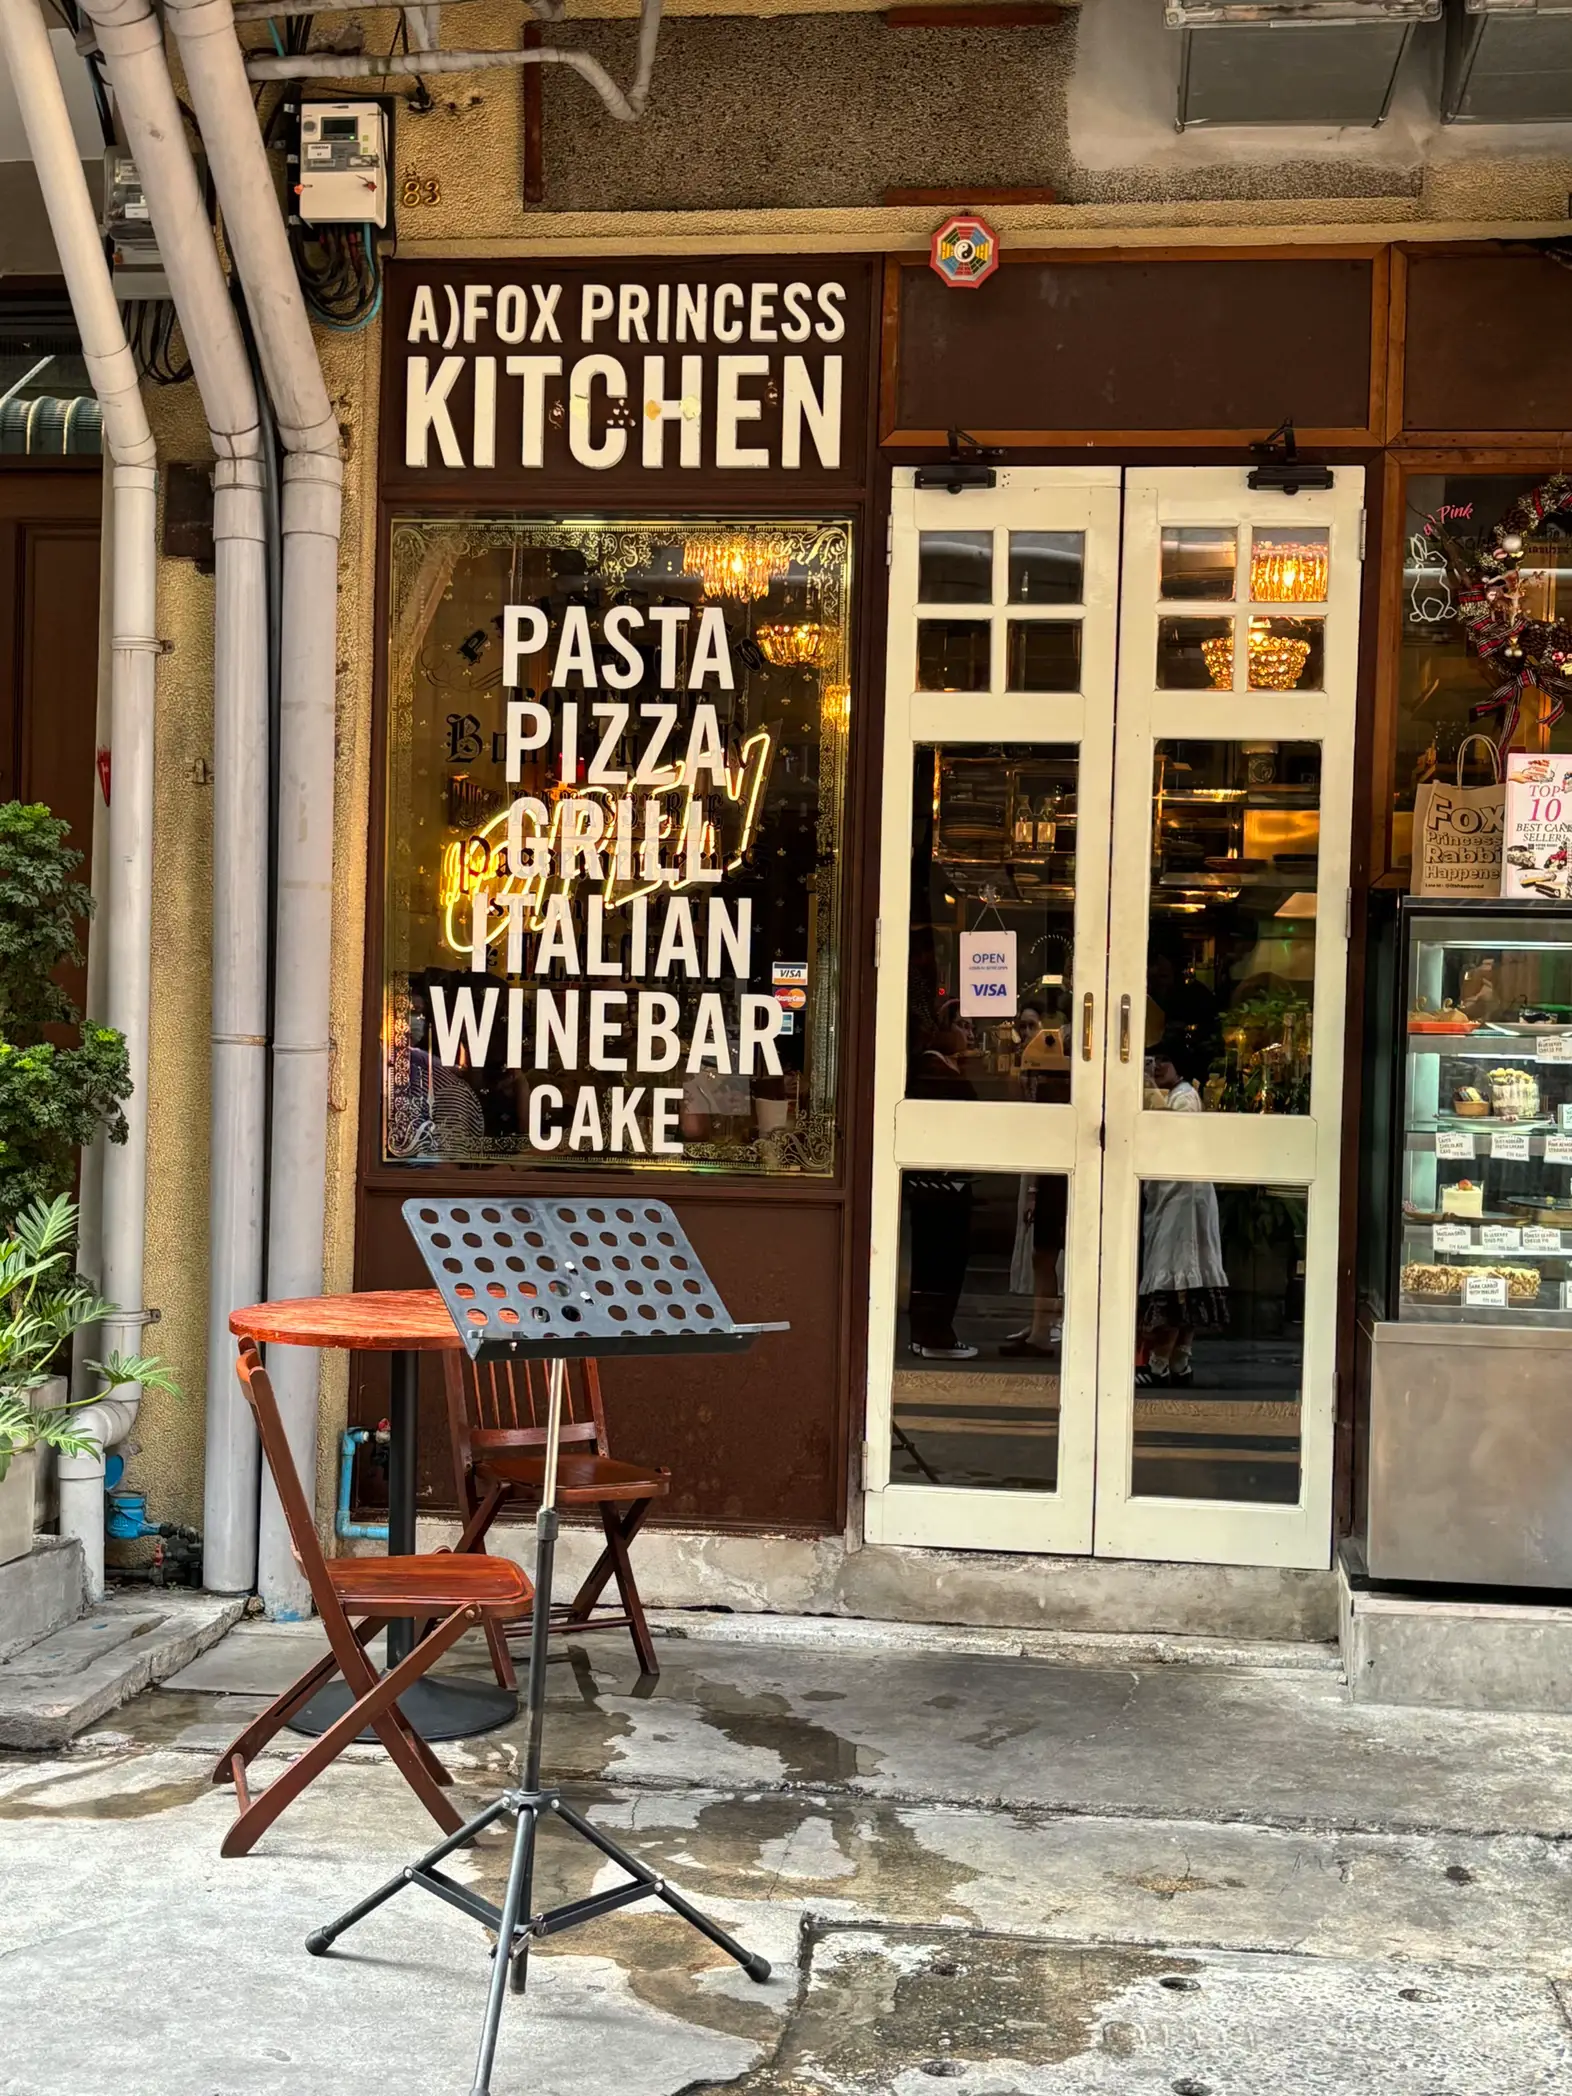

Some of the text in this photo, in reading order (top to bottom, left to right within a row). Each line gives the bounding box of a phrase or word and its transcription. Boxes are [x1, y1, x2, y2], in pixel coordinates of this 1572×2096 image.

[403, 180, 441, 206] 83
[406, 282, 847, 350] A)FOX PRINCESS
[404, 353, 843, 470] KITCHEN
[1436, 502, 1474, 525] Pink
[502, 604, 735, 690] PASTA
[505, 702, 728, 787] PIZZA
[1529, 785, 1561, 798] TOP
[1528, 798, 1562, 822] 10
[506, 796, 724, 883] GRILL
[1426, 829, 1503, 847] Princess
[1516, 823, 1543, 832] BEST
[1425, 843, 1502, 864] Rabbi
[1425, 865, 1501, 882] Happene
[471, 893, 753, 979] ITALIAN
[972, 953, 1005, 964] OPEN
[779, 969, 802, 978] VISA
[970, 983, 1007, 997] VISA
[429, 986, 785, 1076] WINEBAR
[528, 1085, 685, 1154] CAKE
